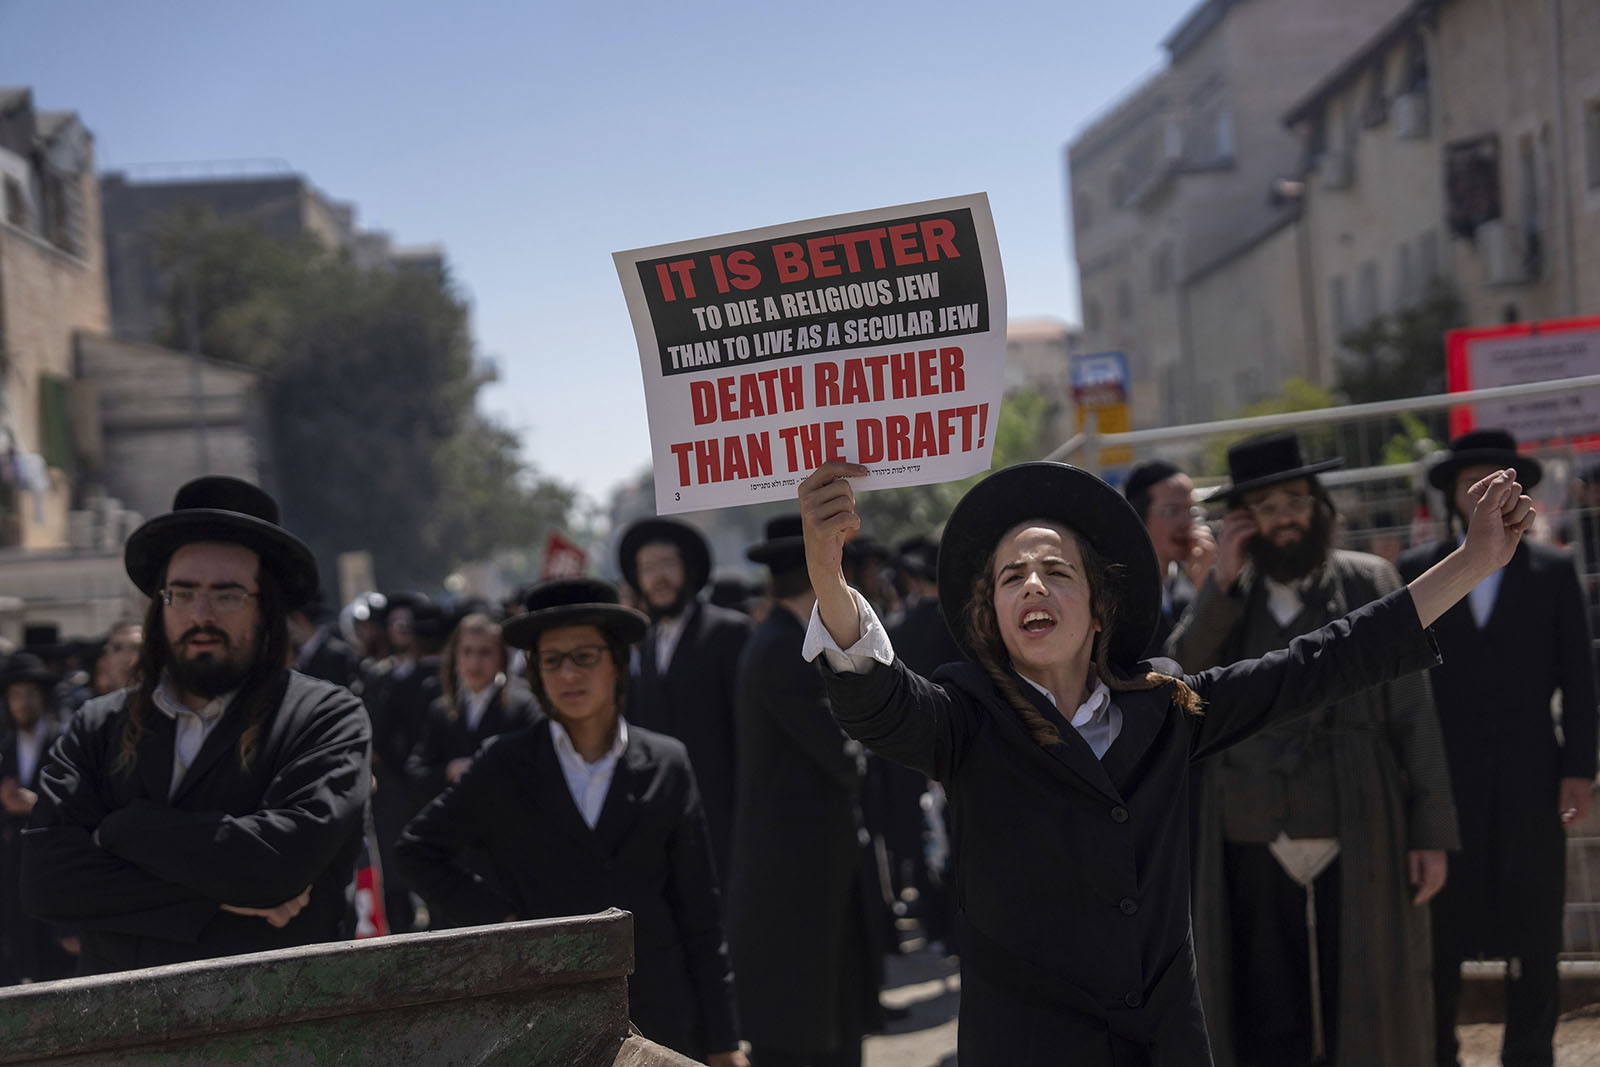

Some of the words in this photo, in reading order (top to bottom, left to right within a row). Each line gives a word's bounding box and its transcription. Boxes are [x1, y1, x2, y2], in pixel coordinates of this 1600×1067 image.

[656, 260, 696, 302] IT
[709, 251, 762, 294] IS
[772, 219, 960, 284] BETTER
[693, 307, 723, 331] TO
[726, 301, 761, 327] DIE
[764, 297, 781, 320] A
[783, 277, 893, 317] RELIGIOUS
[897, 273, 940, 301] JEW
[668, 339, 721, 369] THAN
[723, 337, 751, 360] TO
[754, 329, 793, 357] LIVE
[797, 326, 822, 350] AS
[827, 323, 841, 345] A
[845, 312, 933, 343] SECULAR
[938, 304, 979, 332] JEW
[690, 366, 804, 425] DEATH
[815, 347, 965, 407] RATHER
[671, 431, 772, 487] THAN
[779, 421, 845, 472] THE
[856, 404, 989, 464] DRAFT!
[871, 468, 890, 476] כיהודי
[891, 465, 906, 474] למות
[907, 465, 920, 473] עדיף
[675, 492, 681, 501] 3
